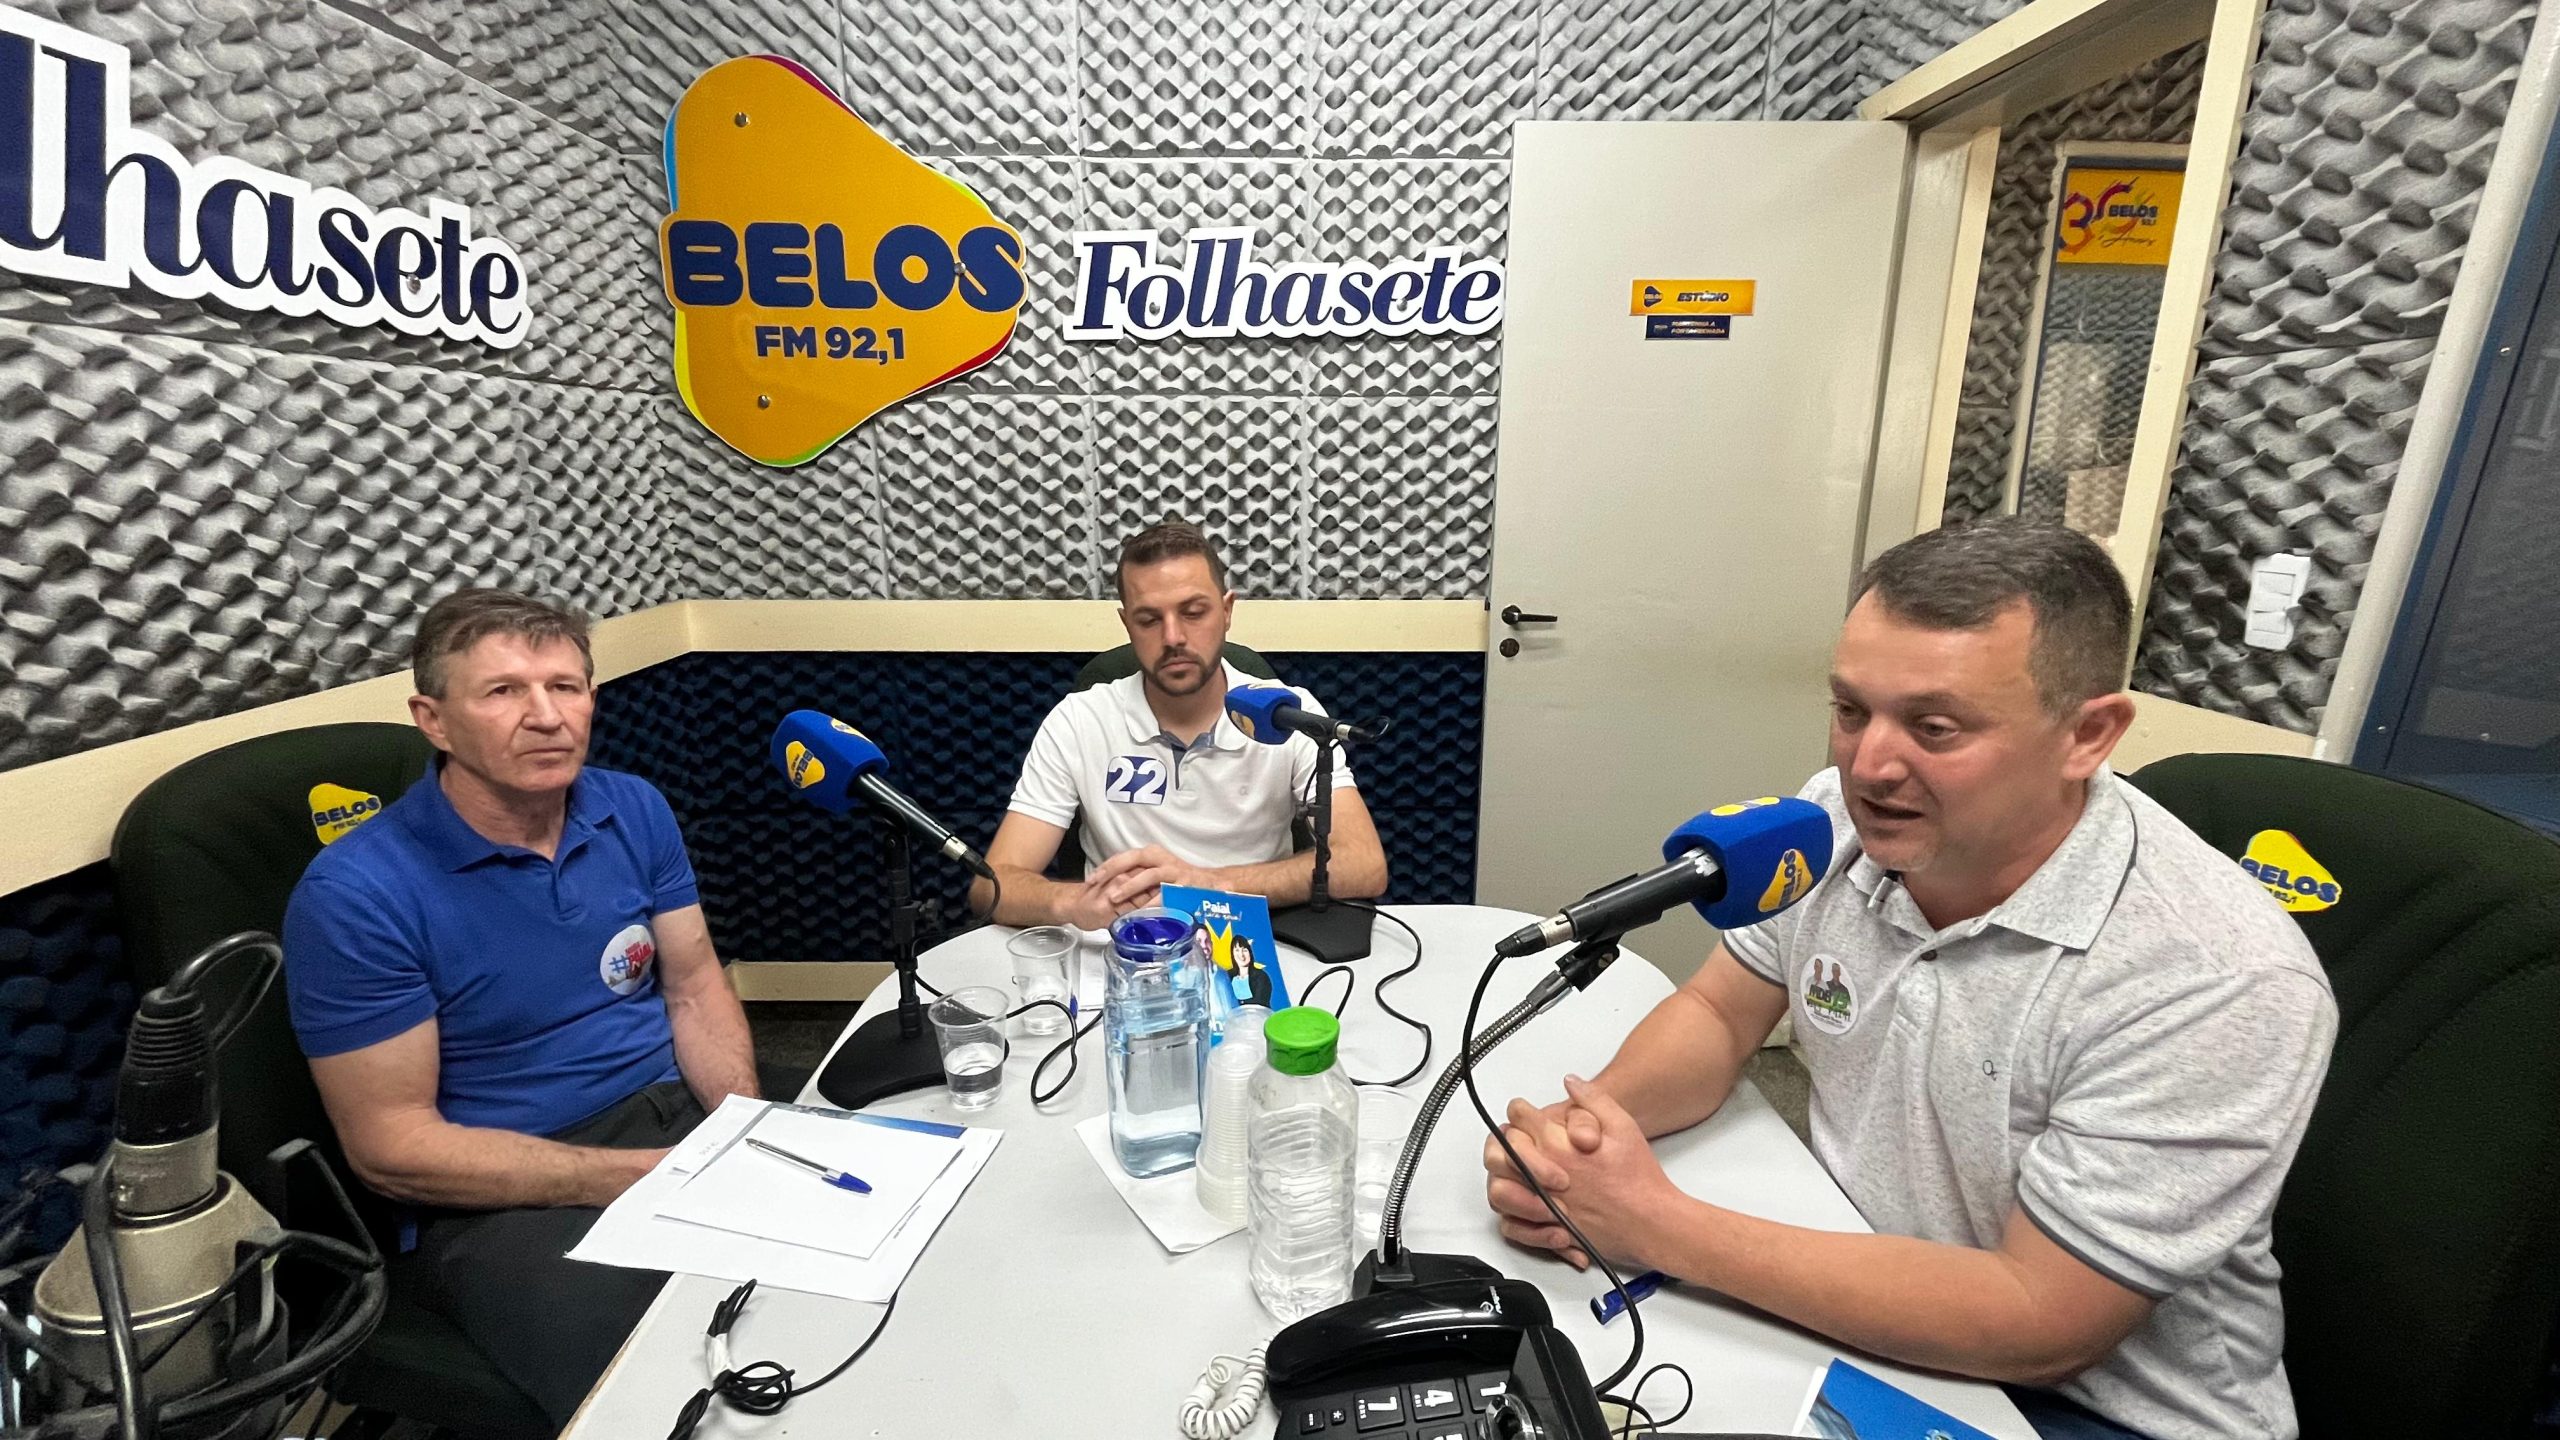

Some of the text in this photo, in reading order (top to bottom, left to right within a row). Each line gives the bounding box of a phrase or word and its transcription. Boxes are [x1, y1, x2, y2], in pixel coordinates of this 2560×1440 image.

[668, 220, 1025, 313] BELOS
[1072, 237, 1502, 330] Folhasete
[755, 325, 905, 366] FM 92,1
[1106, 757, 1167, 805] 22
[314, 797, 379, 827] BELOS
[1368, 1397, 1397, 1411] 7
[1424, 1390, 1454, 1407] 4
[1480, 1382, 1507, 1397] 1
